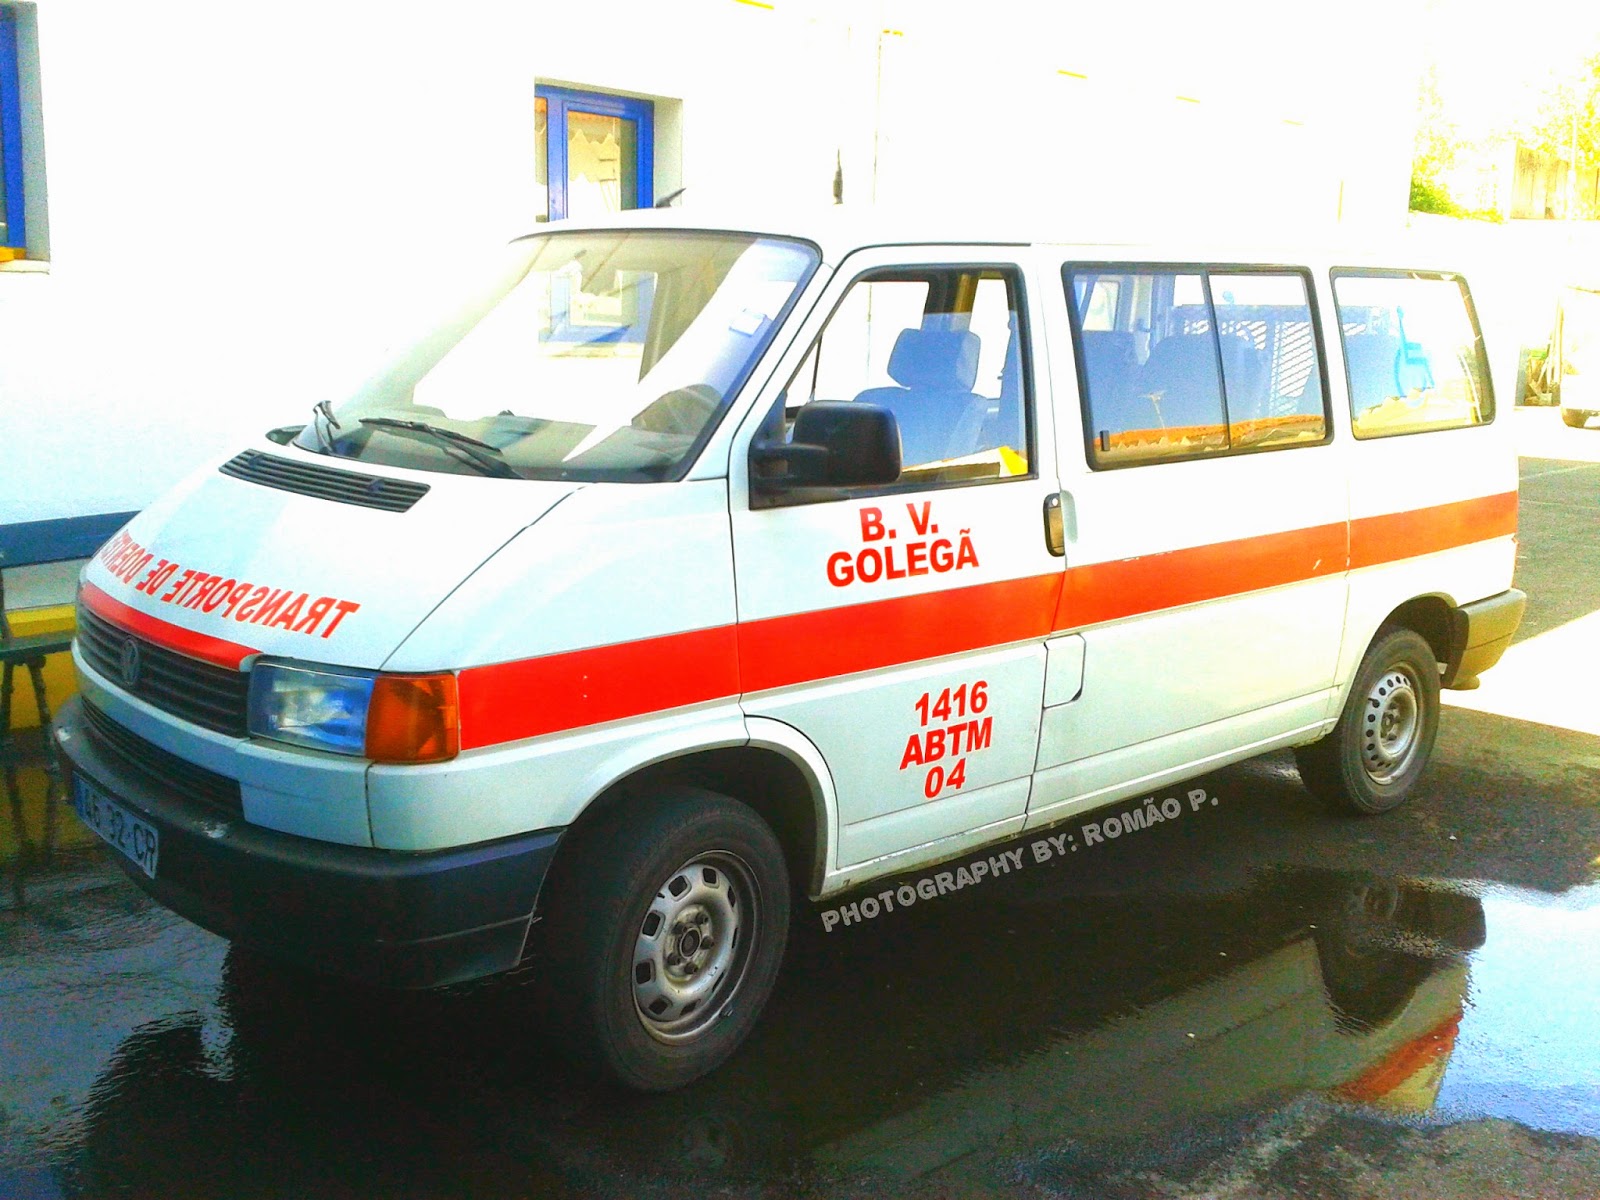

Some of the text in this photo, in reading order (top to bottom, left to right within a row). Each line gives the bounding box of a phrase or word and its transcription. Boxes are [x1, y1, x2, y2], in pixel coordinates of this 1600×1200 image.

[859, 501, 939, 542] B. V.
[826, 528, 980, 588] GOLEGÃ
[914, 680, 989, 727] 1416
[899, 716, 993, 770] ABTM
[923, 758, 966, 798] 04
